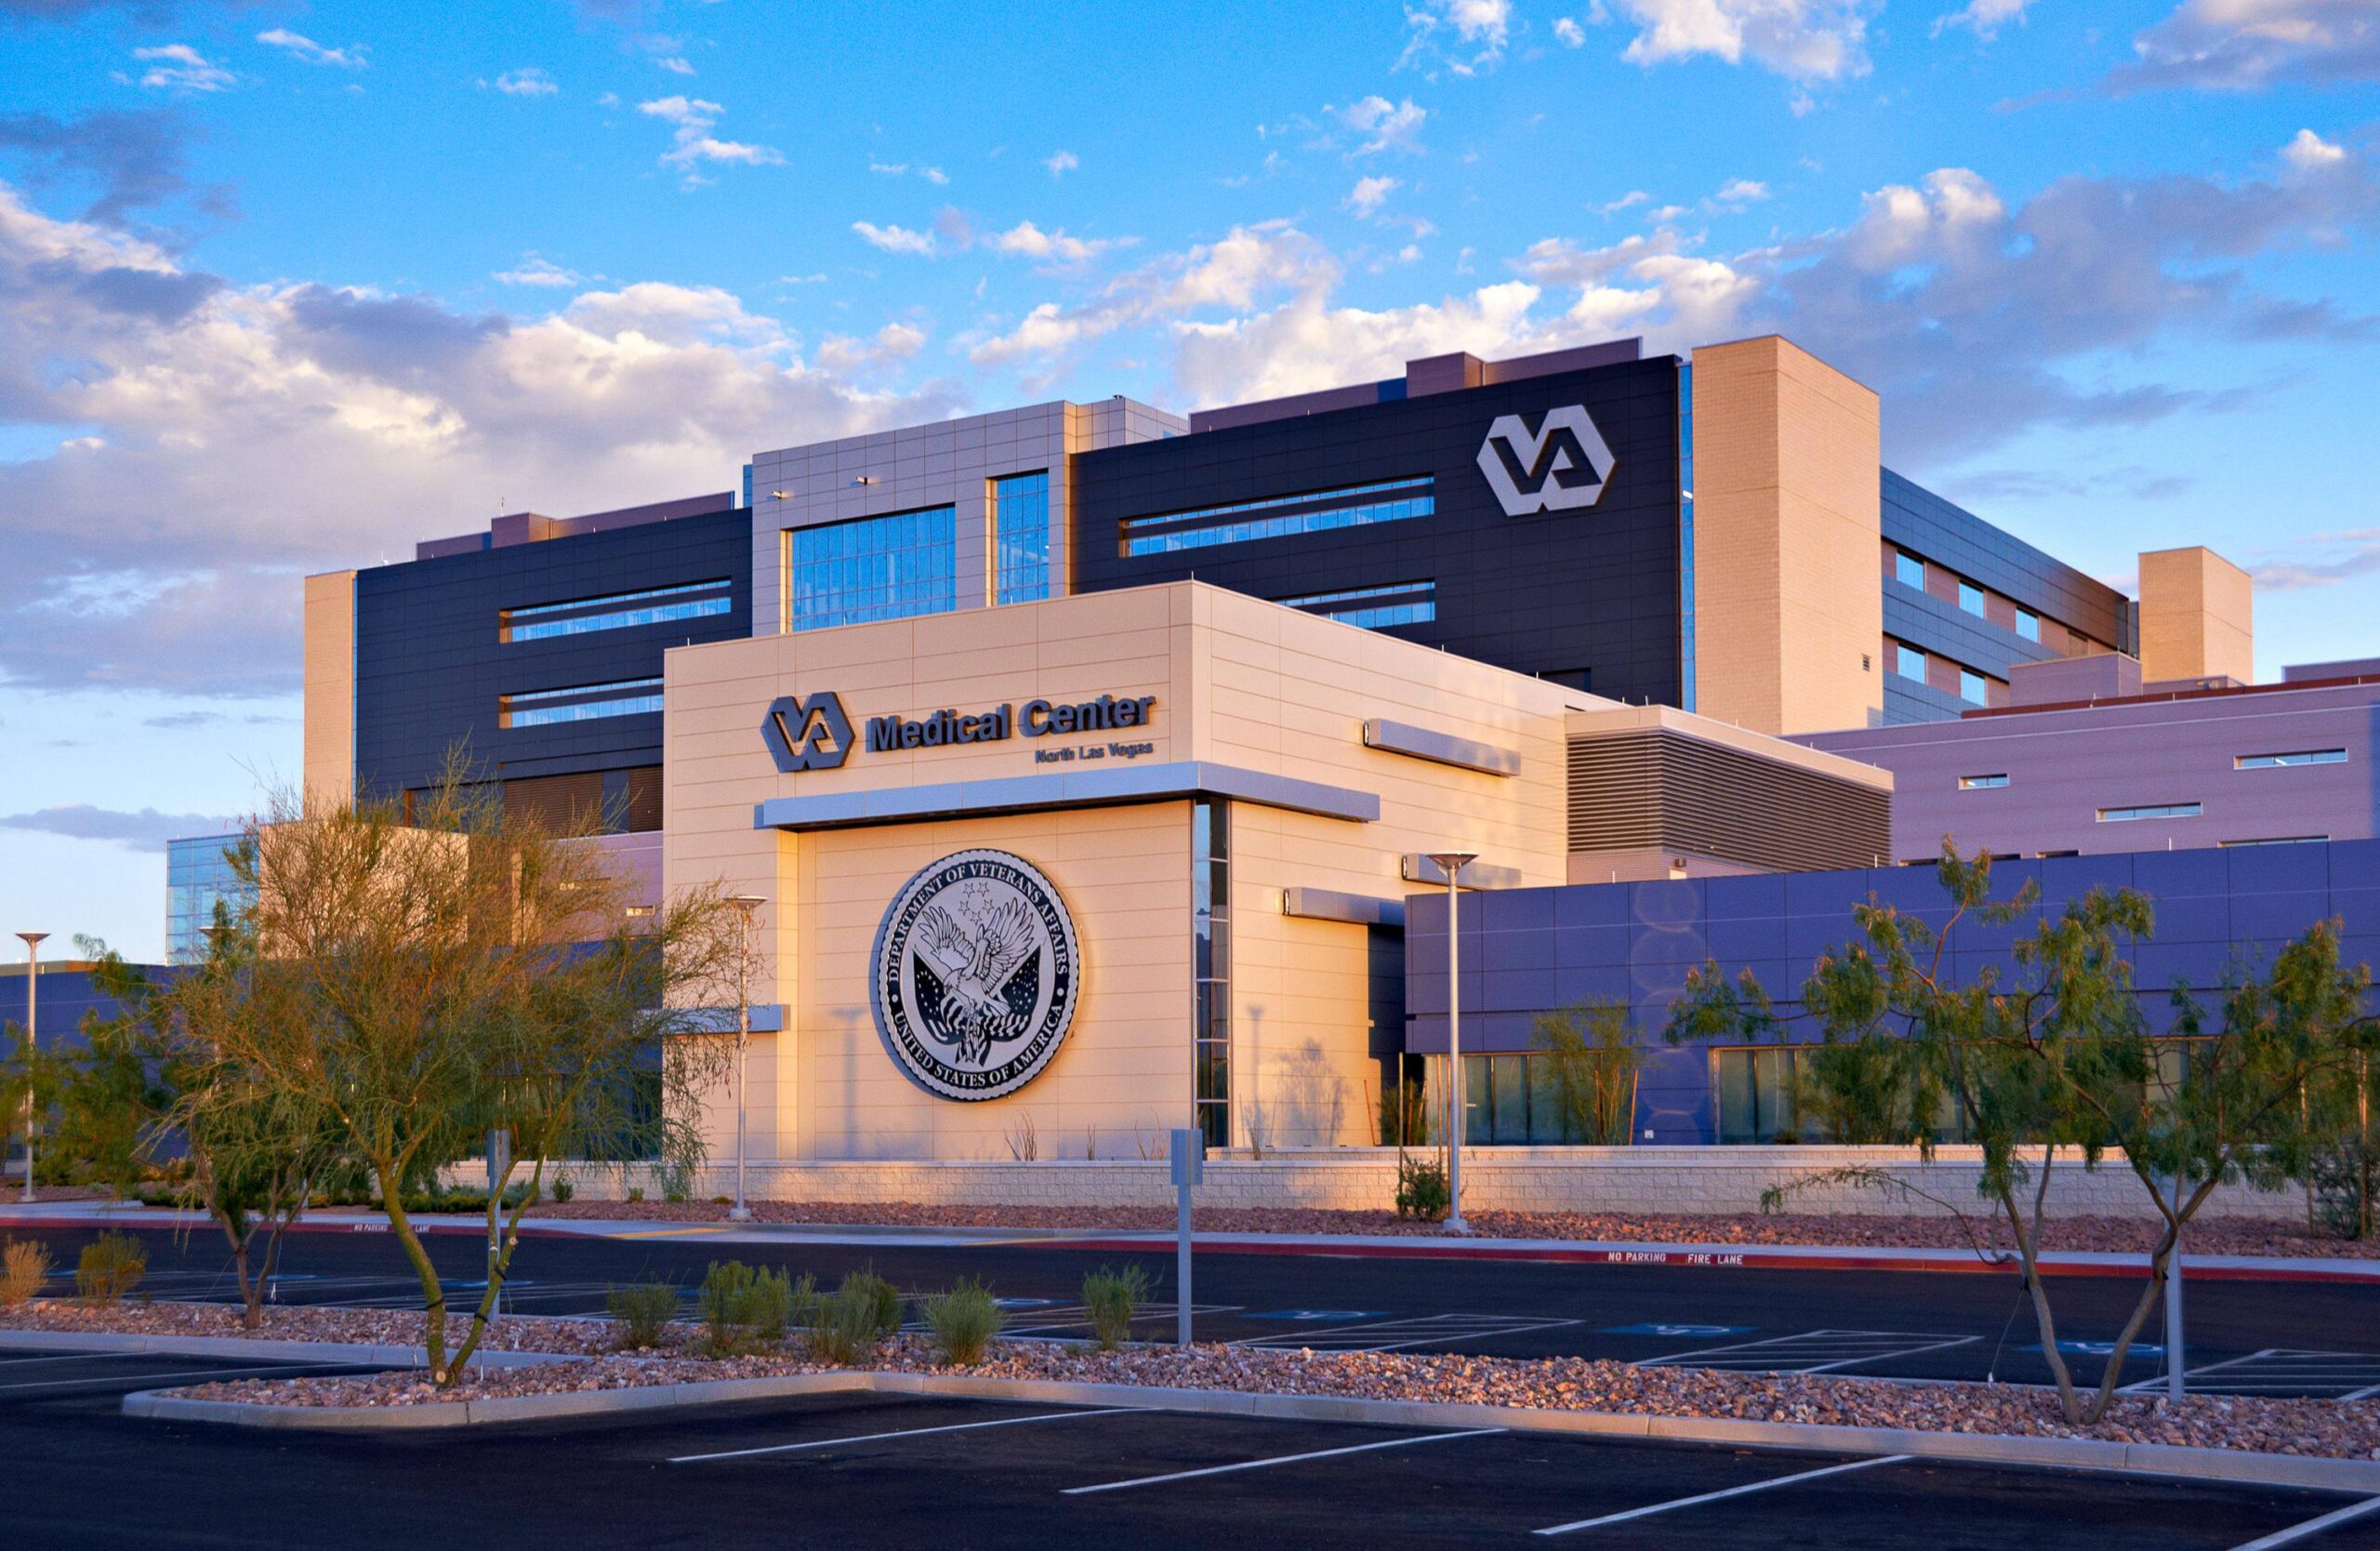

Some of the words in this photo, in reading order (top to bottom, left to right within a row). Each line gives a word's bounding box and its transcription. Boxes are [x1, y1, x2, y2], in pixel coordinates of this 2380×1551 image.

[1476, 404, 1616, 517] VA
[760, 691, 855, 774] VA
[866, 704, 1012, 752] Medical
[1018, 694, 1157, 737] Center
[1035, 747, 1075, 763] North
[1078, 746, 1104, 760] Las
[1107, 743, 1153, 759] Vegas
[889, 874, 945, 982] DEPARTMENT
[945, 866, 966, 882] OF
[970, 863, 1042, 902] VETERANS
[1037, 903, 1068, 974] AFFAIRS
[894, 1011, 933, 1069] UNITED
[934, 1064, 985, 1086] STATES
[989, 1070, 1010, 1086] OF
[1012, 1004, 1063, 1076] AMERICA
[364, 1224, 388, 1232] PARKING
[415, 1225, 431, 1233] LANE
[1607, 1252, 1621, 1262] NO
[1625, 1253, 1666, 1263] PARKING
[1687, 1253, 1712, 1265] FIRE
[1717, 1254, 1744, 1265] LANE
